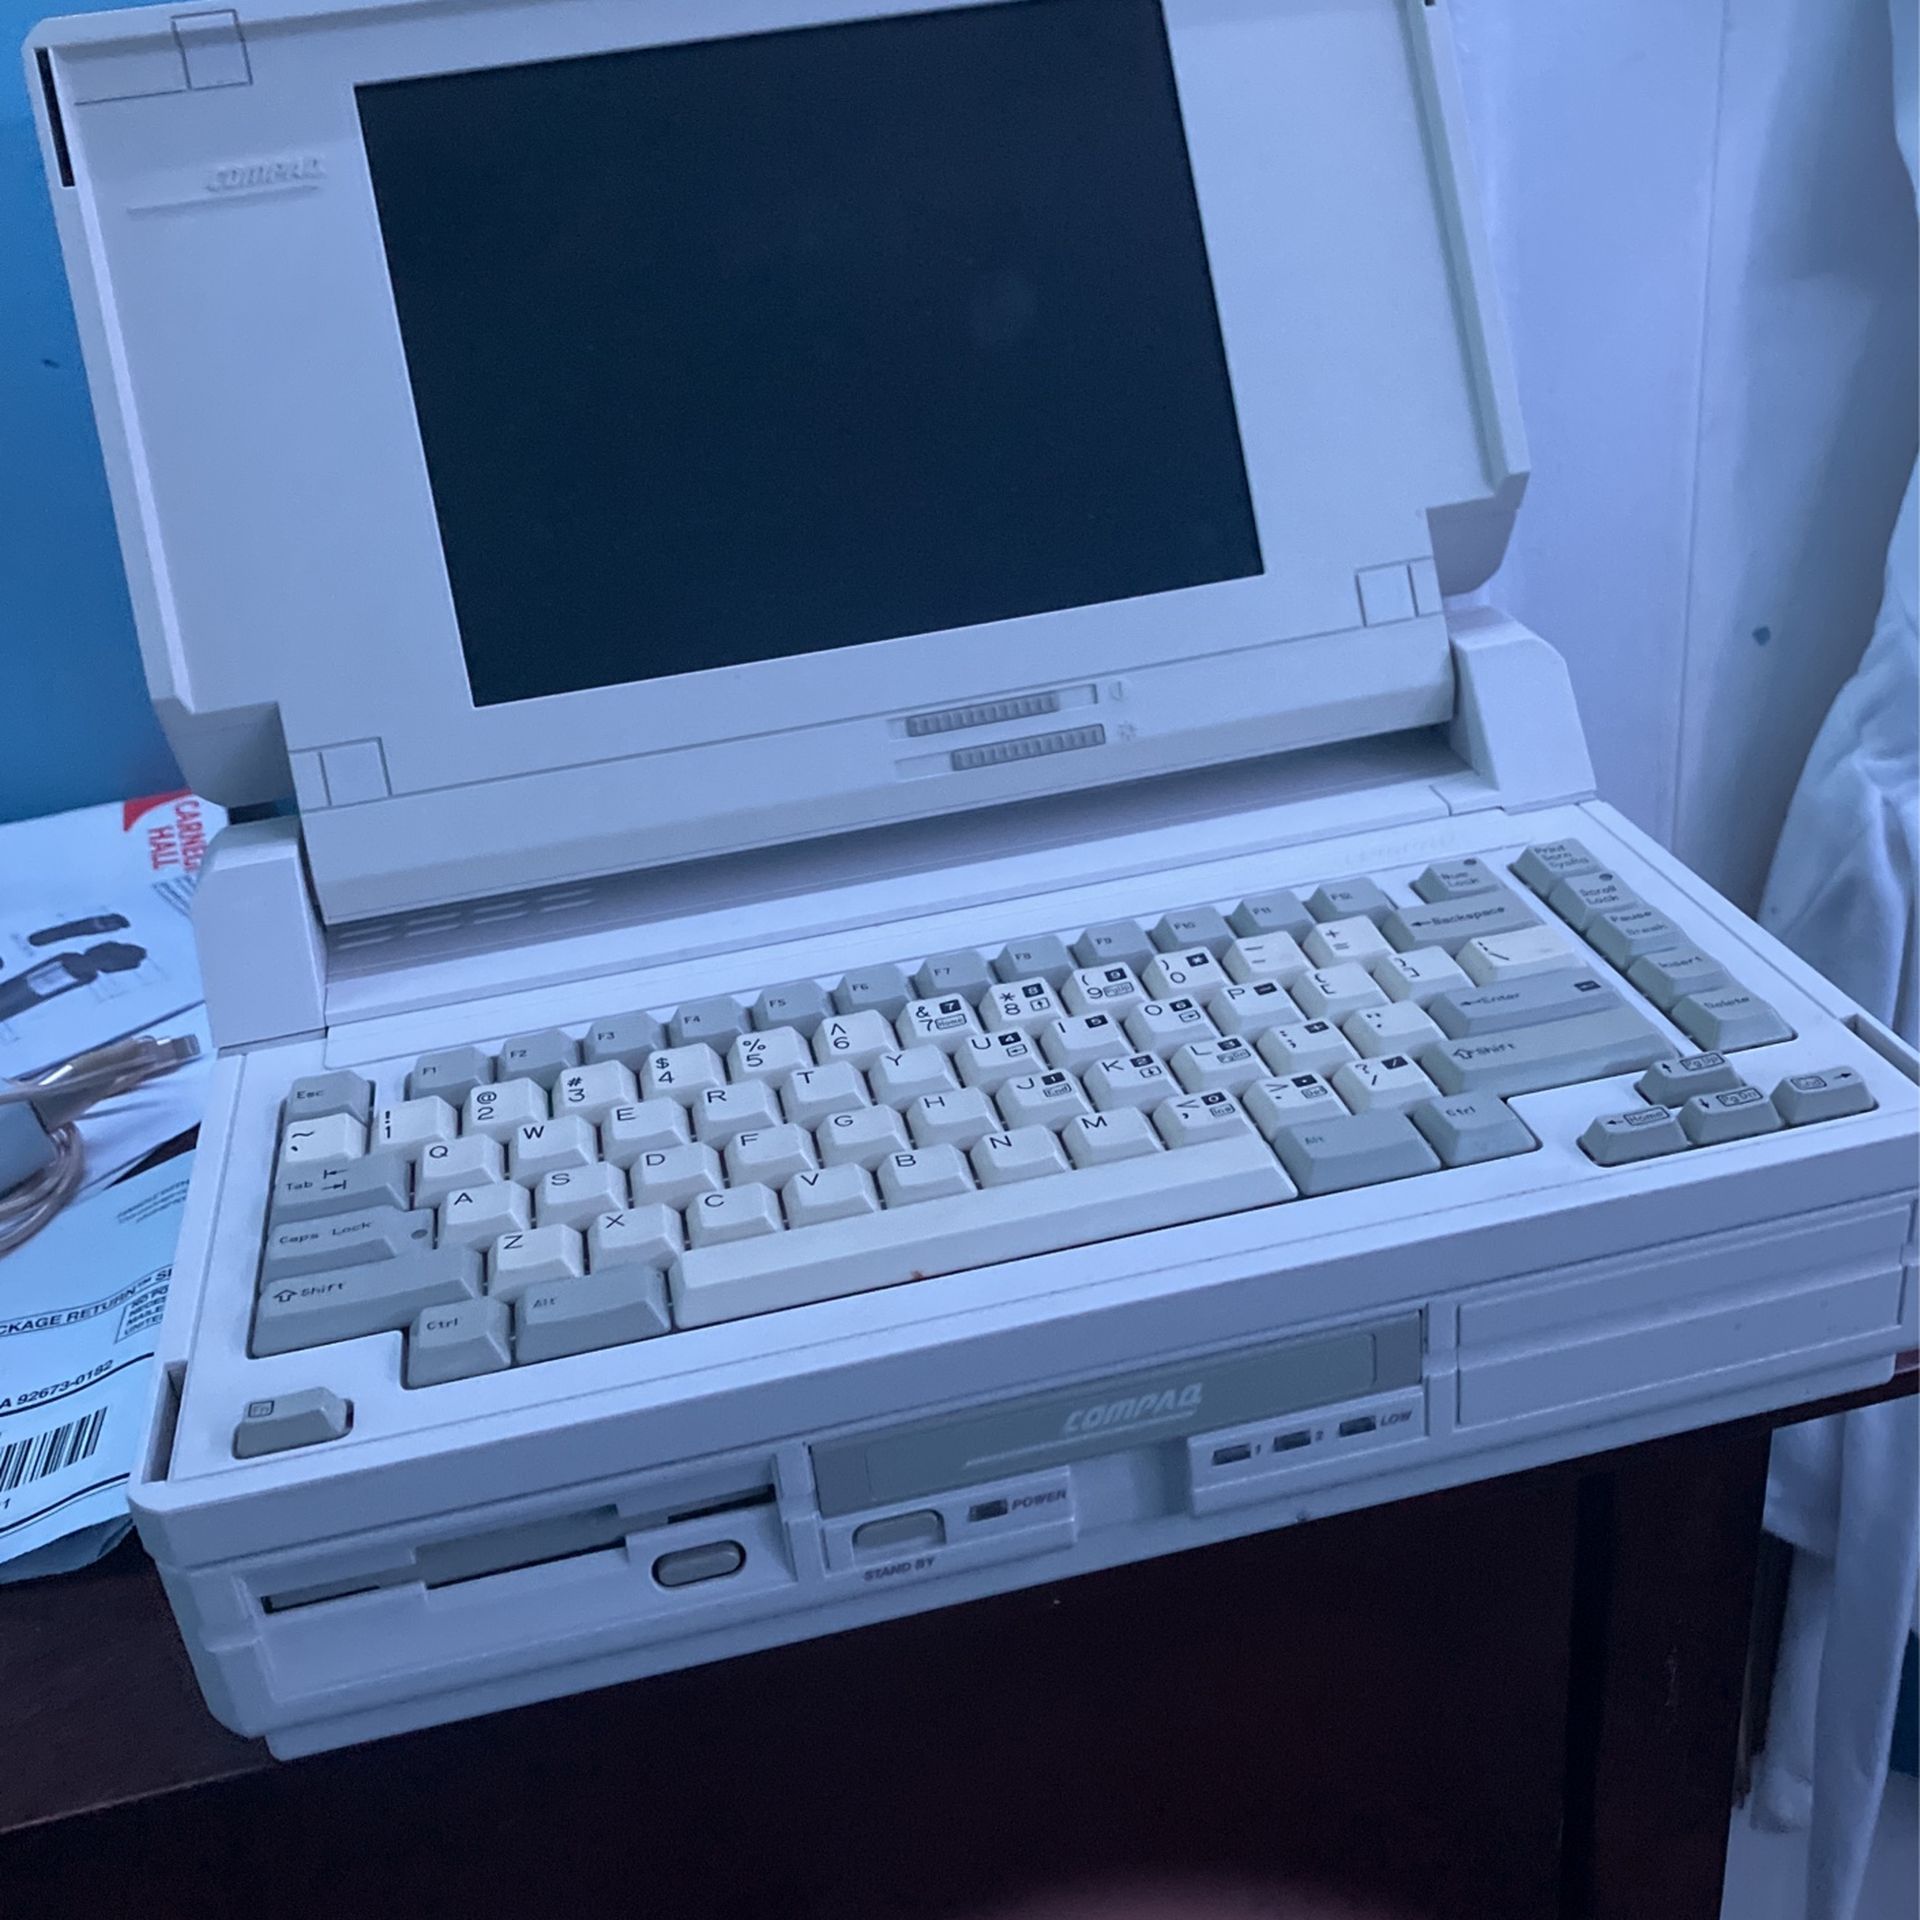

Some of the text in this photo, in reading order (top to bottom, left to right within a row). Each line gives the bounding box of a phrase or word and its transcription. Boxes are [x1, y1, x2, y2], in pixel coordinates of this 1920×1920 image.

[147, 825, 180, 870] HALL
[1431, 906, 1505, 925] Backspace
[1174, 921, 1196, 930] F10
[1096, 937, 1112, 945] F9
[934, 967, 951, 976] F7
[852, 983, 869, 992] F6
[1087, 987, 1103, 999] 9
[1227, 988, 1245, 1000] P
[769, 999, 786, 1008] F5
[1004, 1003, 1021, 1016] 8
[1144, 1004, 1163, 1016] O
[915, 1005, 931, 1018] &
[684, 1015, 701, 1024] F4
[918, 1019, 934, 1032] 7
[597, 1032, 615, 1041] F3
[833, 1036, 850, 1049] 6
[742, 1038, 766, 1052] %
[971, 1037, 992, 1050] U
[510, 1050, 527, 1059] F2
[1190, 1046, 1212, 1056] L
[656, 1057, 670, 1069] $
[746, 1054, 764, 1067] 5
[886, 1054, 903, 1067] Y
[1102, 1060, 1124, 1072] K
[422, 1066, 437, 1075] F1
[658, 1070, 675, 1084] 4
[797, 1070, 814, 1084] T
[567, 1077, 582, 1087] #
[1016, 1077, 1035, 1090] J
[296, 1089, 325, 1099] Esc
[476, 1091, 497, 1105] @
[568, 1088, 585, 1102] 3
[706, 1090, 727, 1104] R
[924, 1096, 945, 1109] H
[477, 1106, 494, 1120] 2
[616, 1107, 636, 1121] E
[834, 1115, 854, 1126] G
[1081, 1114, 1108, 1129] M
[385, 1126, 391, 1139] 1
[523, 1125, 545, 1140] W
[740, 1133, 759, 1147] F
[989, 1135, 1012, 1150] N
[429, 1146, 449, 1159] Q
[646, 1153, 666, 1166] D
[895, 1154, 916, 1167] B
[286, 1181, 313, 1190] Tab
[551, 1173, 570, 1186] S
[800, 1173, 820, 1186] V
[454, 1192, 473, 1205] A
[704, 1194, 724, 1208] C
[605, 1213, 625, 1229] X
[279, 1221, 372, 1244] Caps Lock
[503, 1234, 523, 1249] Z
[300, 1282, 344, 1297] Shift
[533, 1298, 557, 1309] Alt
[426, 1318, 458, 1330] Ctrl
[17, 1359, 114, 1407] 92673-0182
[1062, 1382, 1203, 1436] COMPAQ
[1380, 1408, 1413, 1426] LOW
[1011, 1490, 1067, 1511] POWER
[863, 1561, 912, 1582] STAND
